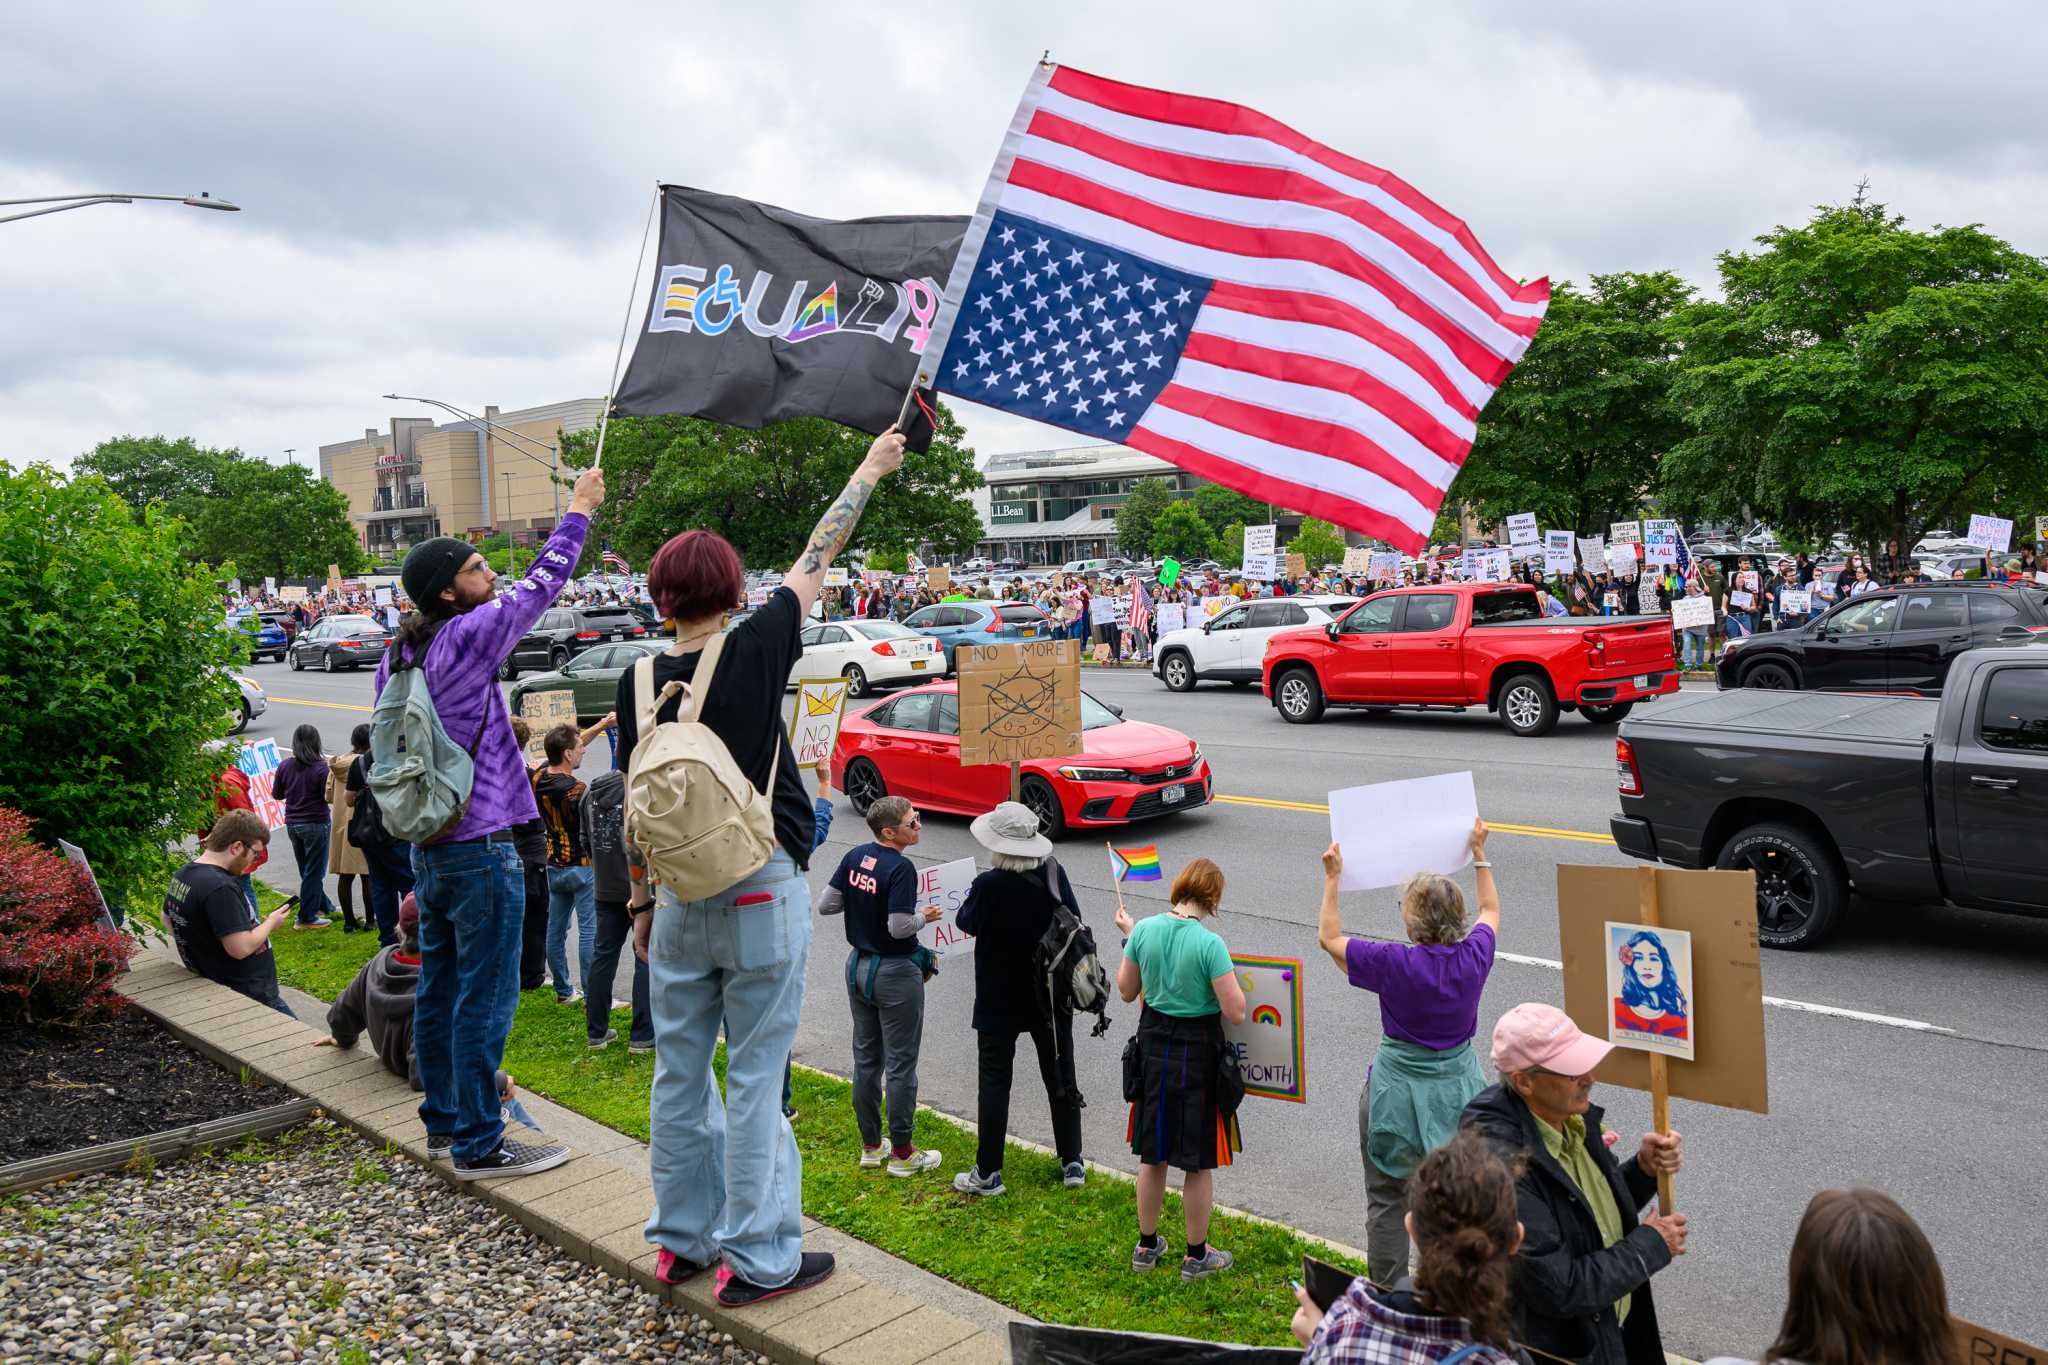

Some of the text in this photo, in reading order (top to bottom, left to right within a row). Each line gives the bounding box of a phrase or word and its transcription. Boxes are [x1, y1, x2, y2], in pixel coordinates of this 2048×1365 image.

[1647, 521, 1675, 529] LIBERTY
[1649, 547, 1673, 556] 4 ALL
[974, 641, 1065, 661] NO MORE
[526, 694, 542, 705] NO
[527, 704, 543, 718] IS
[803, 724, 831, 745] NO
[800, 741, 829, 762] KINGS
[988, 734, 1057, 762] KINGS
[849, 869, 877, 895] USA
[1239, 1063, 1292, 1084] MONTH
